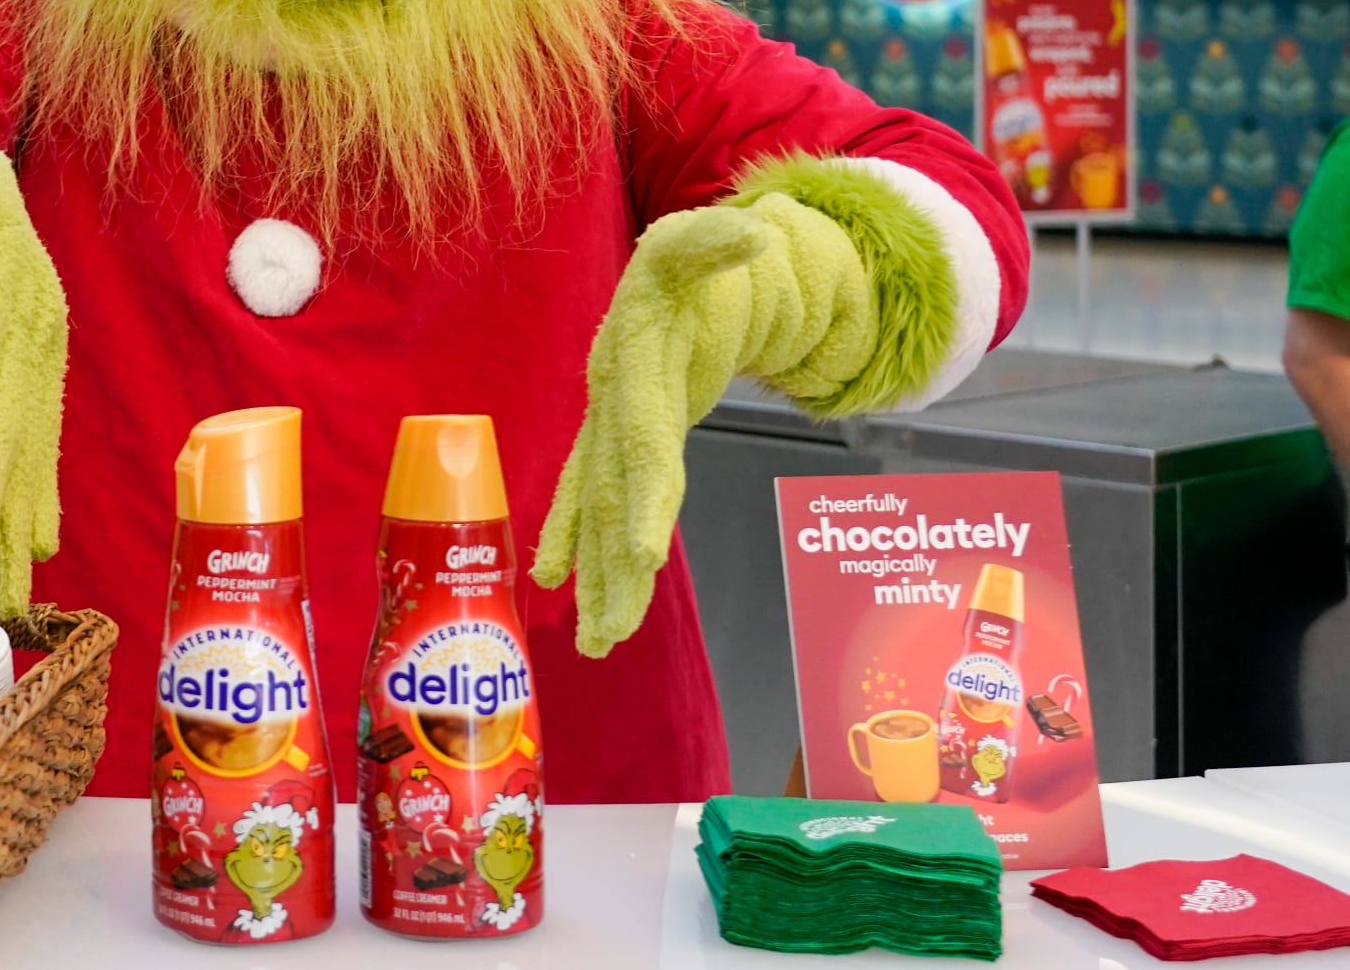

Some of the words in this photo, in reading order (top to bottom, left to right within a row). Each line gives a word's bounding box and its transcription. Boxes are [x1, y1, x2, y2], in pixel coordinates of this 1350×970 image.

[809, 494, 908, 516] cheerfully
[798, 512, 1031, 557] chocolately
[207, 549, 270, 575] GRINCH
[445, 544, 497, 570] GRINCH
[839, 553, 937, 578] magically
[196, 574, 278, 590] PEPPERMINT
[435, 570, 503, 585] PEPPERMINT
[211, 590, 261, 603] MOCHA
[451, 584, 493, 598] MOCHA
[873, 576, 962, 610] minty
[172, 628, 297, 670] INTERNATIONAL
[412, 622, 520, 660] INTERNATIONAL
[158, 662, 308, 724] delight
[388, 659, 530, 716] delight
[948, 669, 1021, 702] delight
[162, 795, 204, 818] GRINCH
[399, 793, 450, 818] GRINCH
